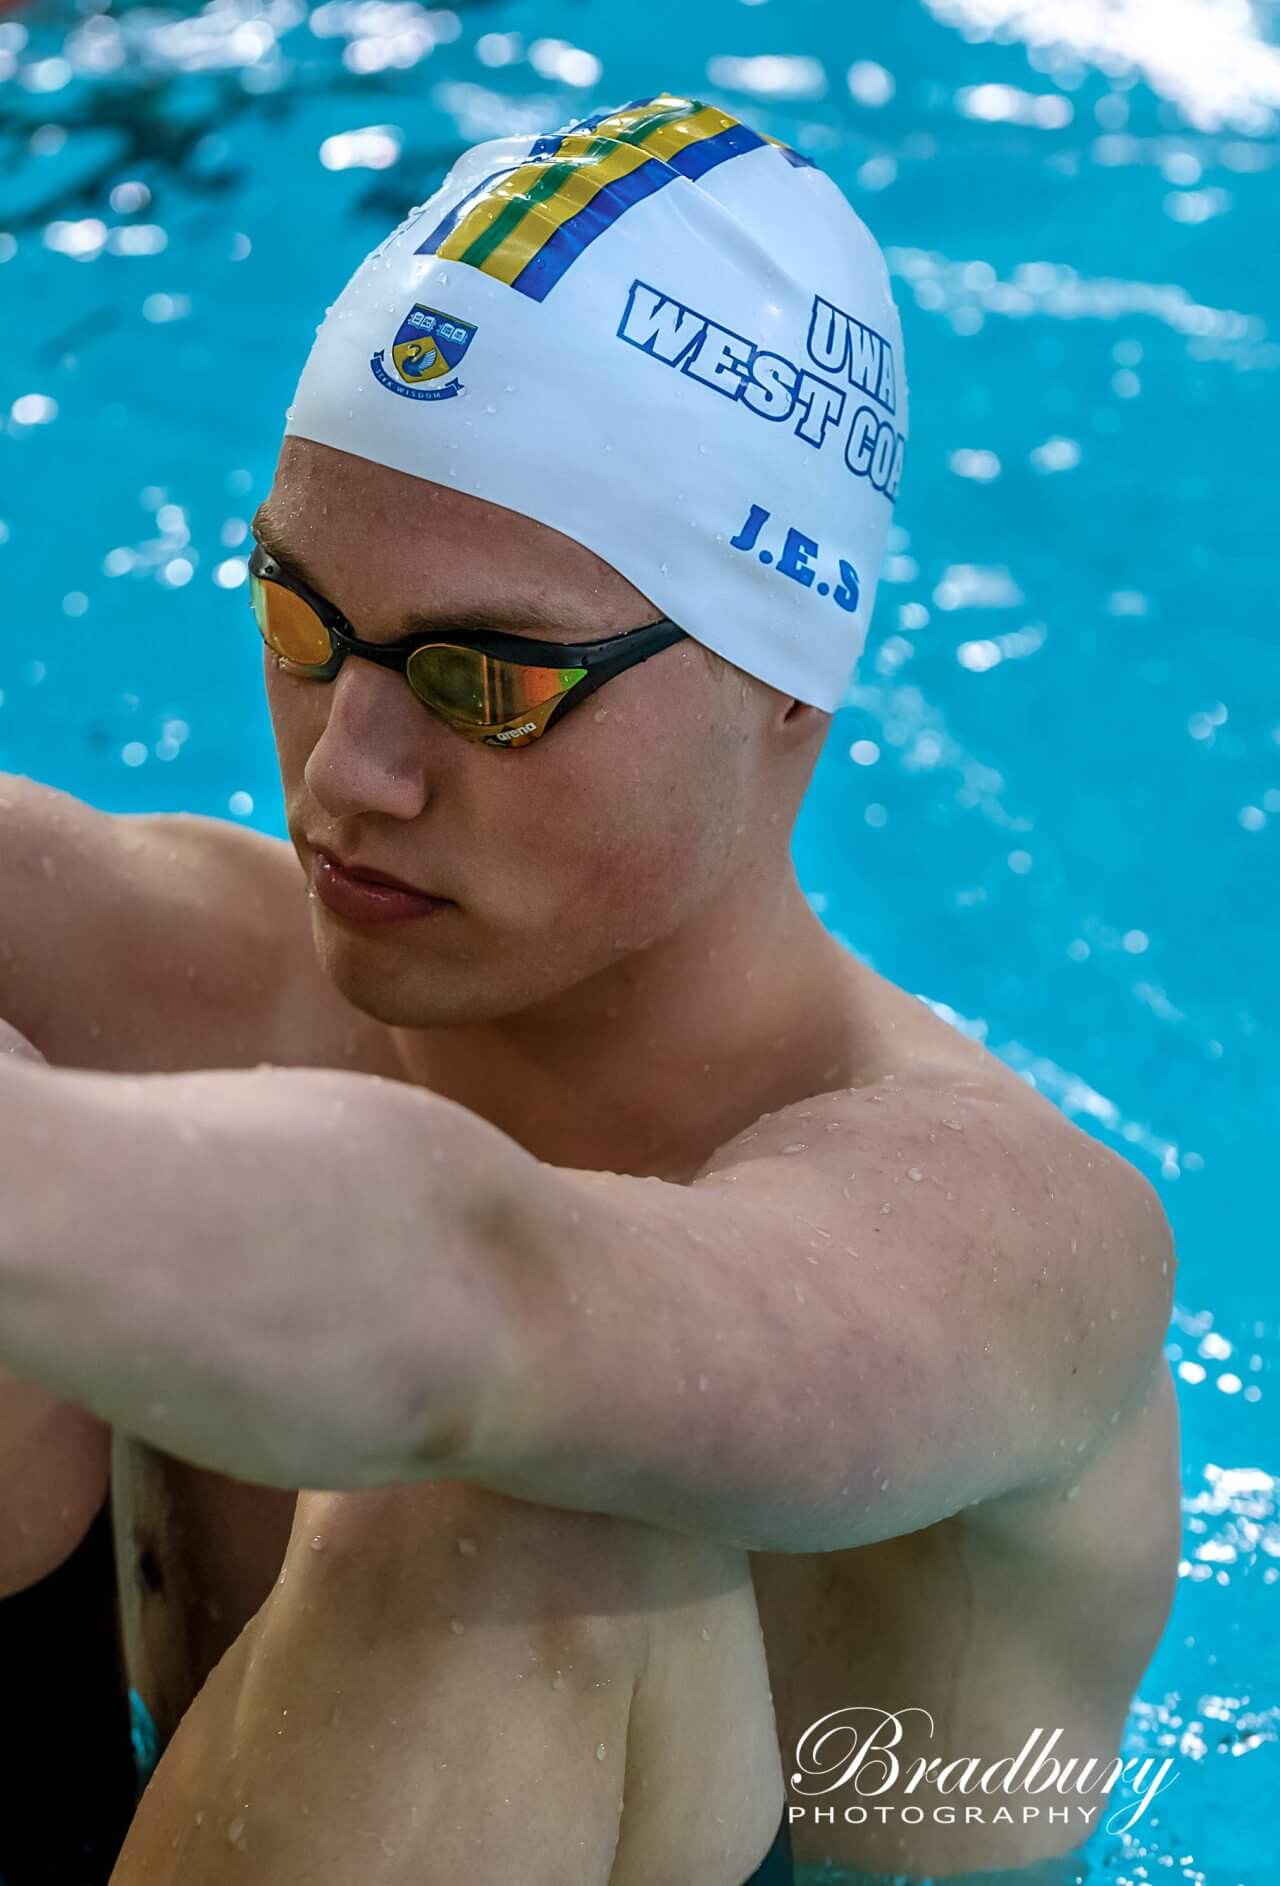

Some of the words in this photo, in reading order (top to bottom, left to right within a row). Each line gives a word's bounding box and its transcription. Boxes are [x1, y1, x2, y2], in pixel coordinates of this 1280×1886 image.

[616, 278, 847, 449] WEST
[806, 294, 897, 416] UWA
[396, 386, 441, 400] WISDOM
[496, 721, 537, 741] arena
